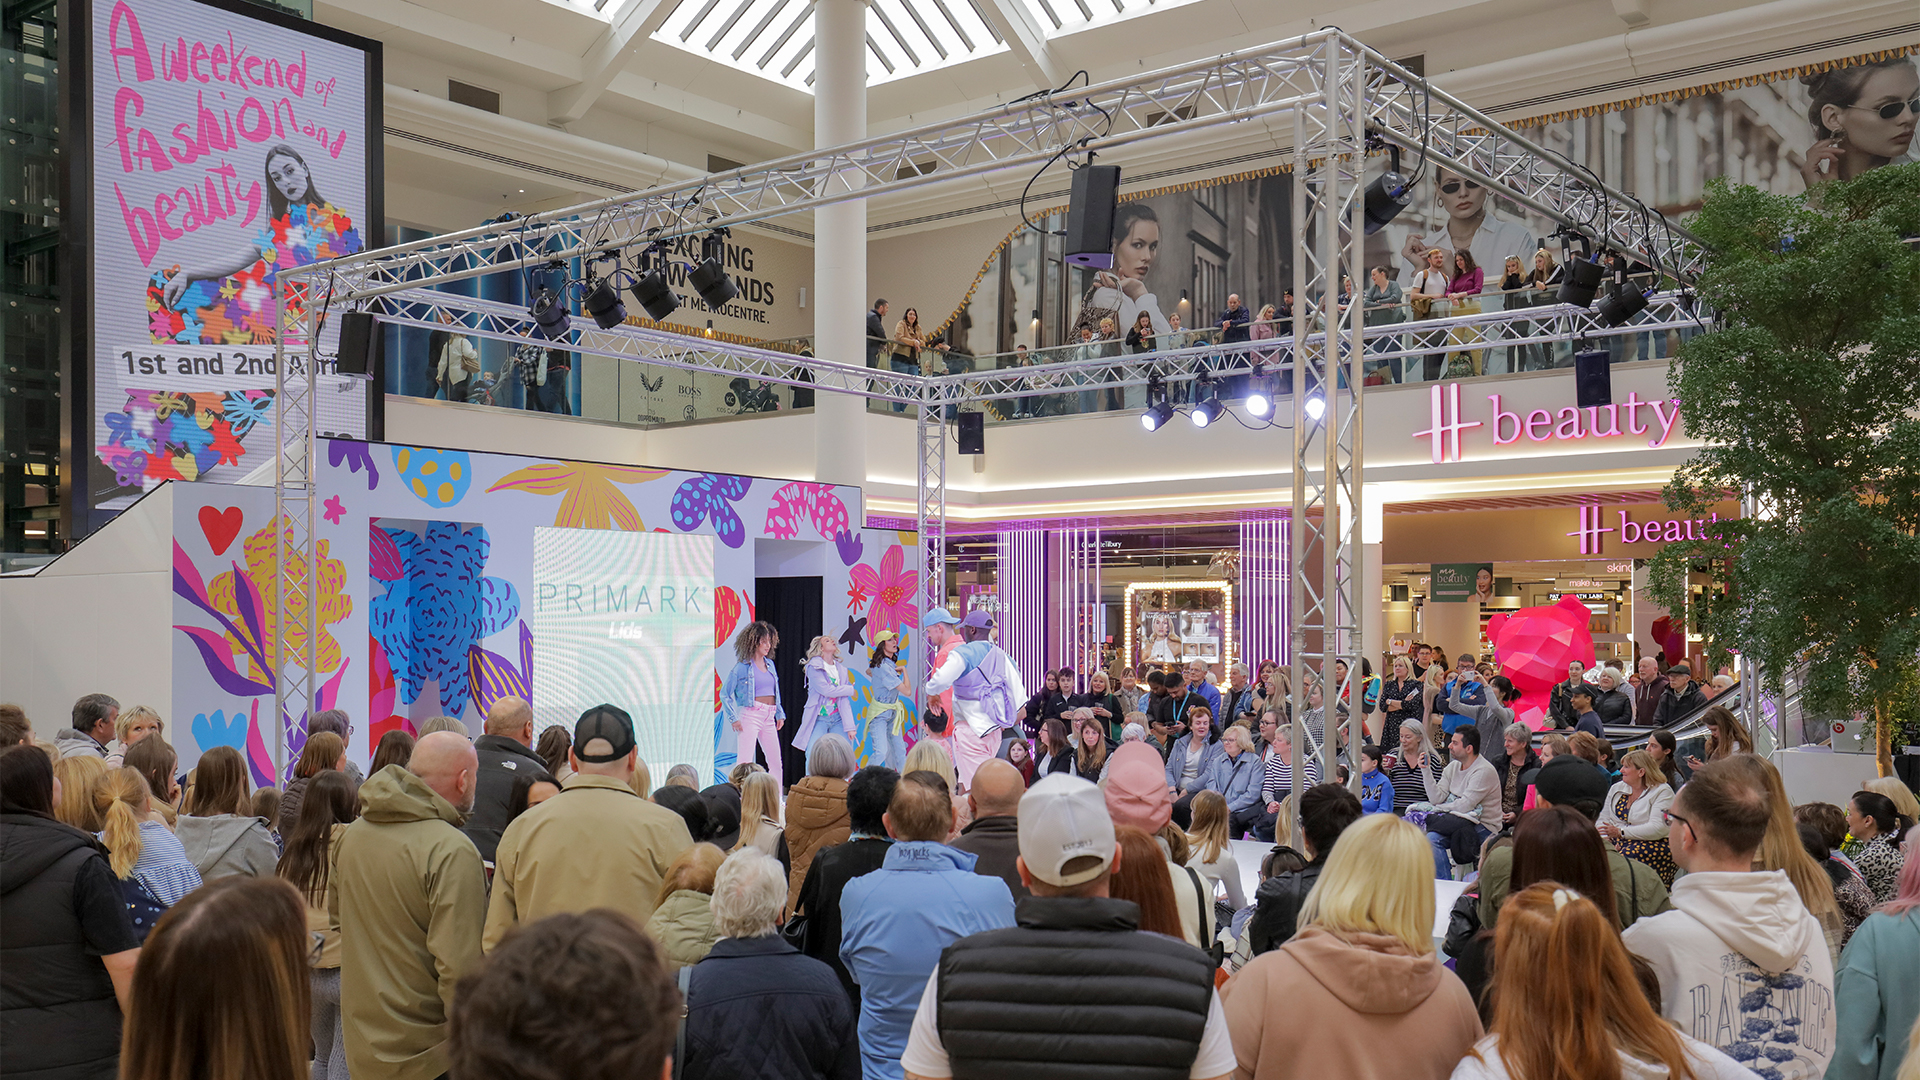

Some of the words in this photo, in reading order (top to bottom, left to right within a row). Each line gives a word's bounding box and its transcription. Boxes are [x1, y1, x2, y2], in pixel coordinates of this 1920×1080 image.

[109, 0, 155, 82] A
[162, 30, 307, 98] weekend
[314, 77, 336, 107] of
[302, 119, 346, 159] and
[114, 158, 261, 268] beauty
[122, 351, 167, 375] 1st
[177, 352, 224, 375] and
[678, 384, 702, 396] BOSS
[1487, 391, 1682, 448] beauty
[1436, 573, 1470, 586] beauty
